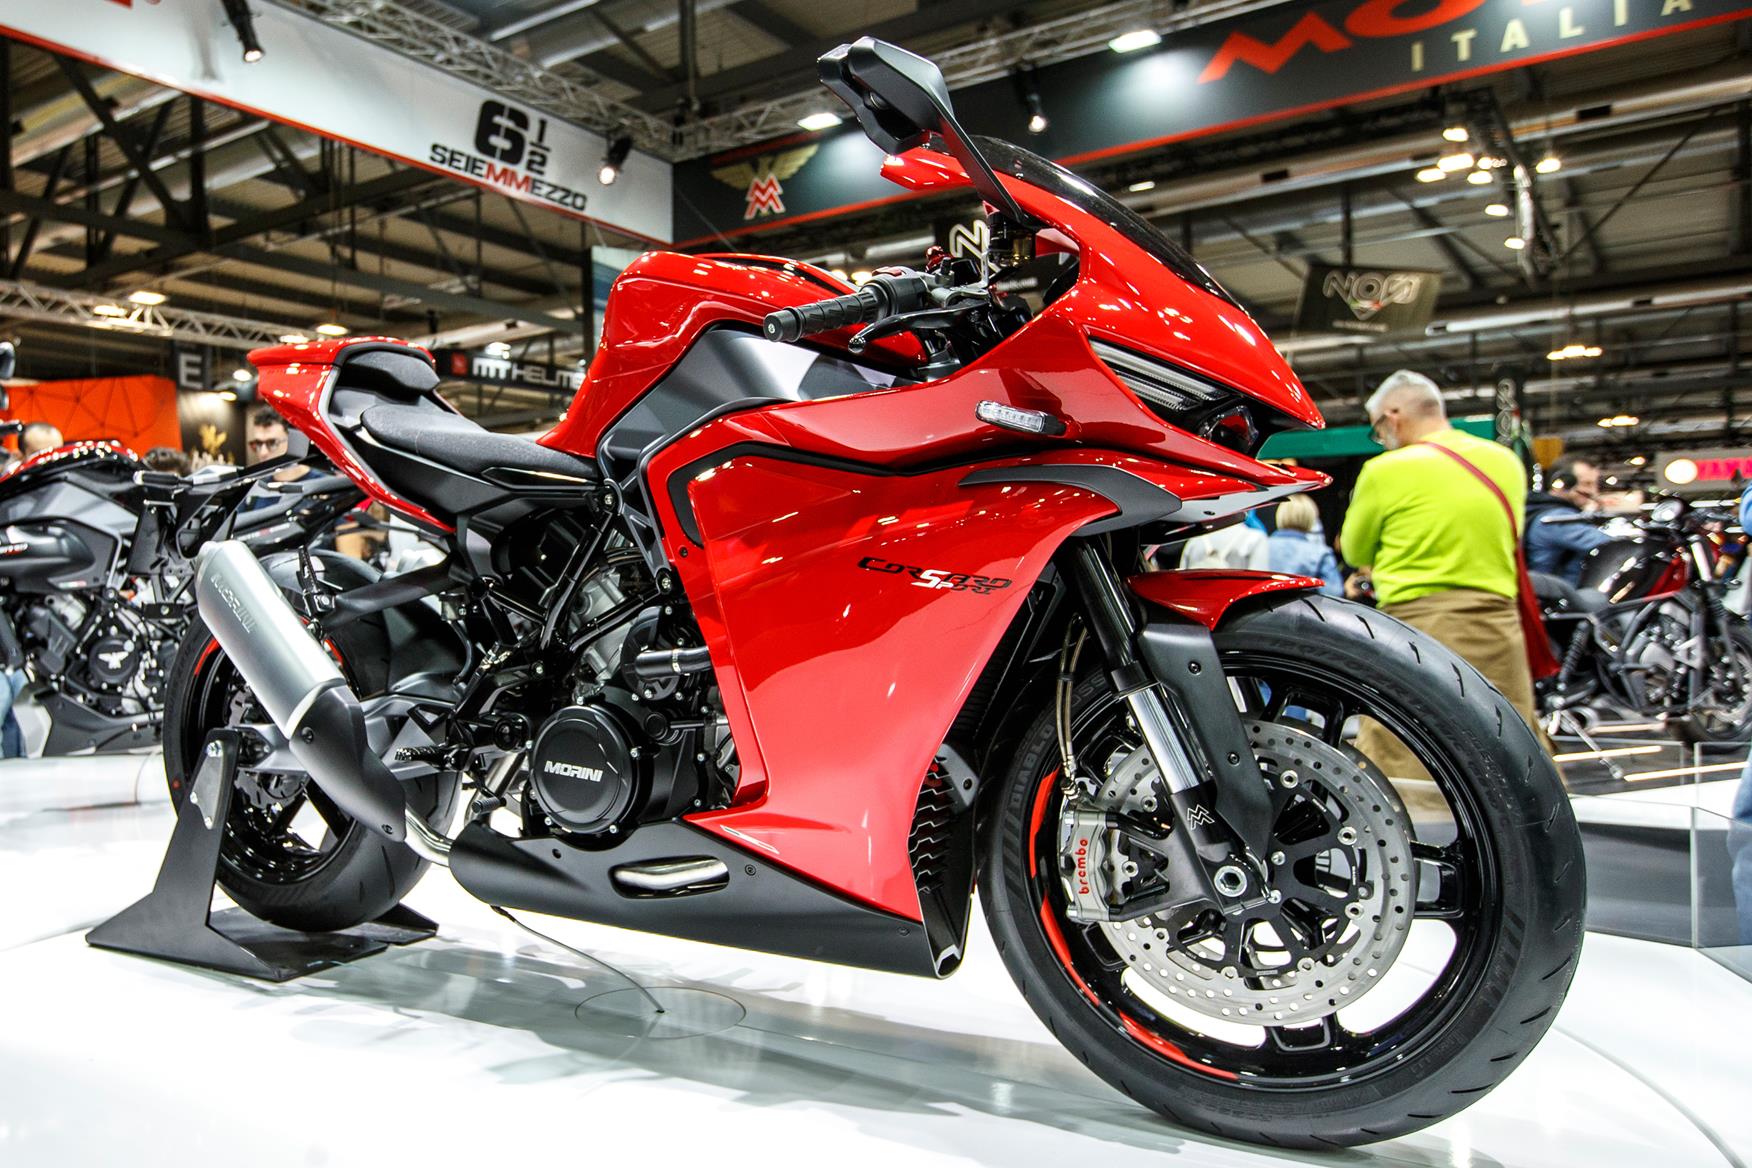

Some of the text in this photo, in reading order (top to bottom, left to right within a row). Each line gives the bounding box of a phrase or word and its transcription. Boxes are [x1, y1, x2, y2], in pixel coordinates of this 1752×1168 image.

[1408, 0, 1694, 73] ITALIA
[429, 143, 589, 212] SEIEMMEZZO
[512, 362, 586, 390] HELME
[543, 760, 604, 783] MORINI
[1008, 723, 1058, 807] DIABLO
[1078, 837, 1090, 896] brembo
